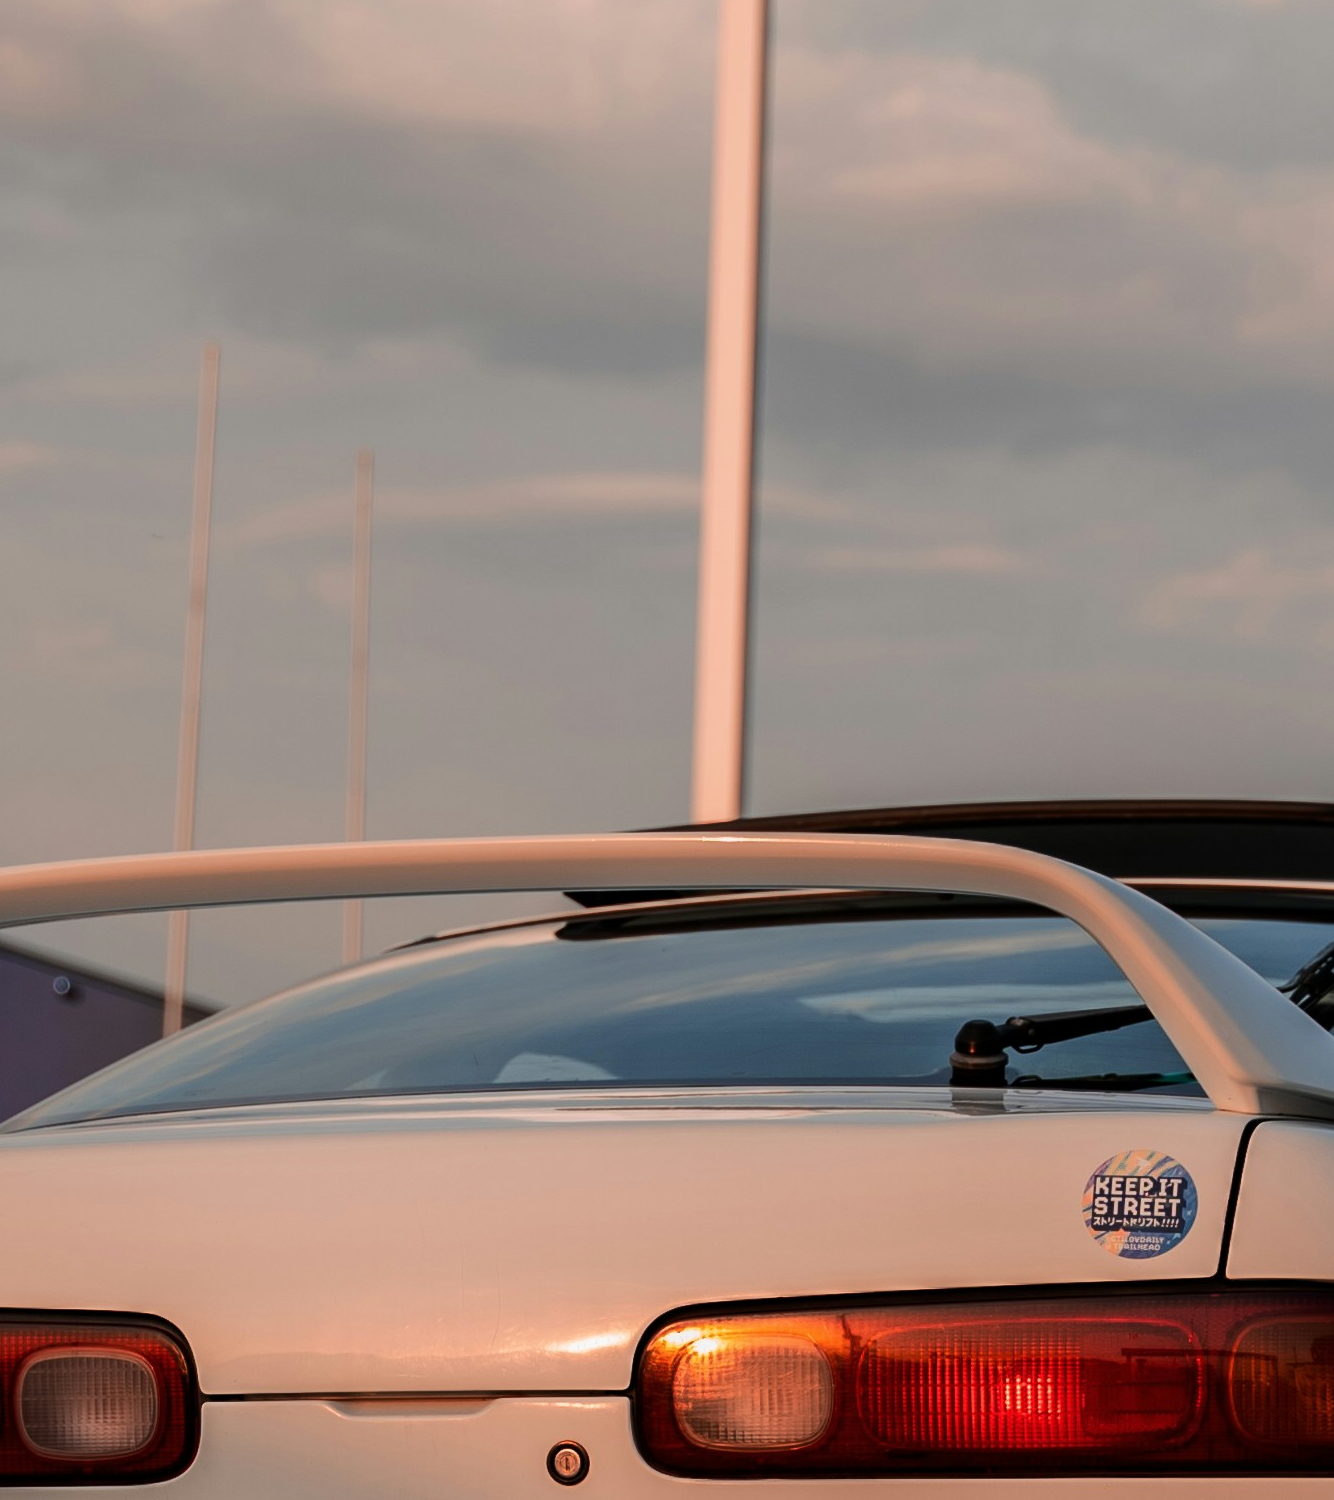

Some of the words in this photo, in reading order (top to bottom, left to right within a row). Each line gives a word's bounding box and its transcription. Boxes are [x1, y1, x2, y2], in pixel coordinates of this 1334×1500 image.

[1095, 1176, 1154, 1196] KEEP
[1158, 1178, 1182, 1198] IT
[1093, 1197, 1181, 1217] STREET
